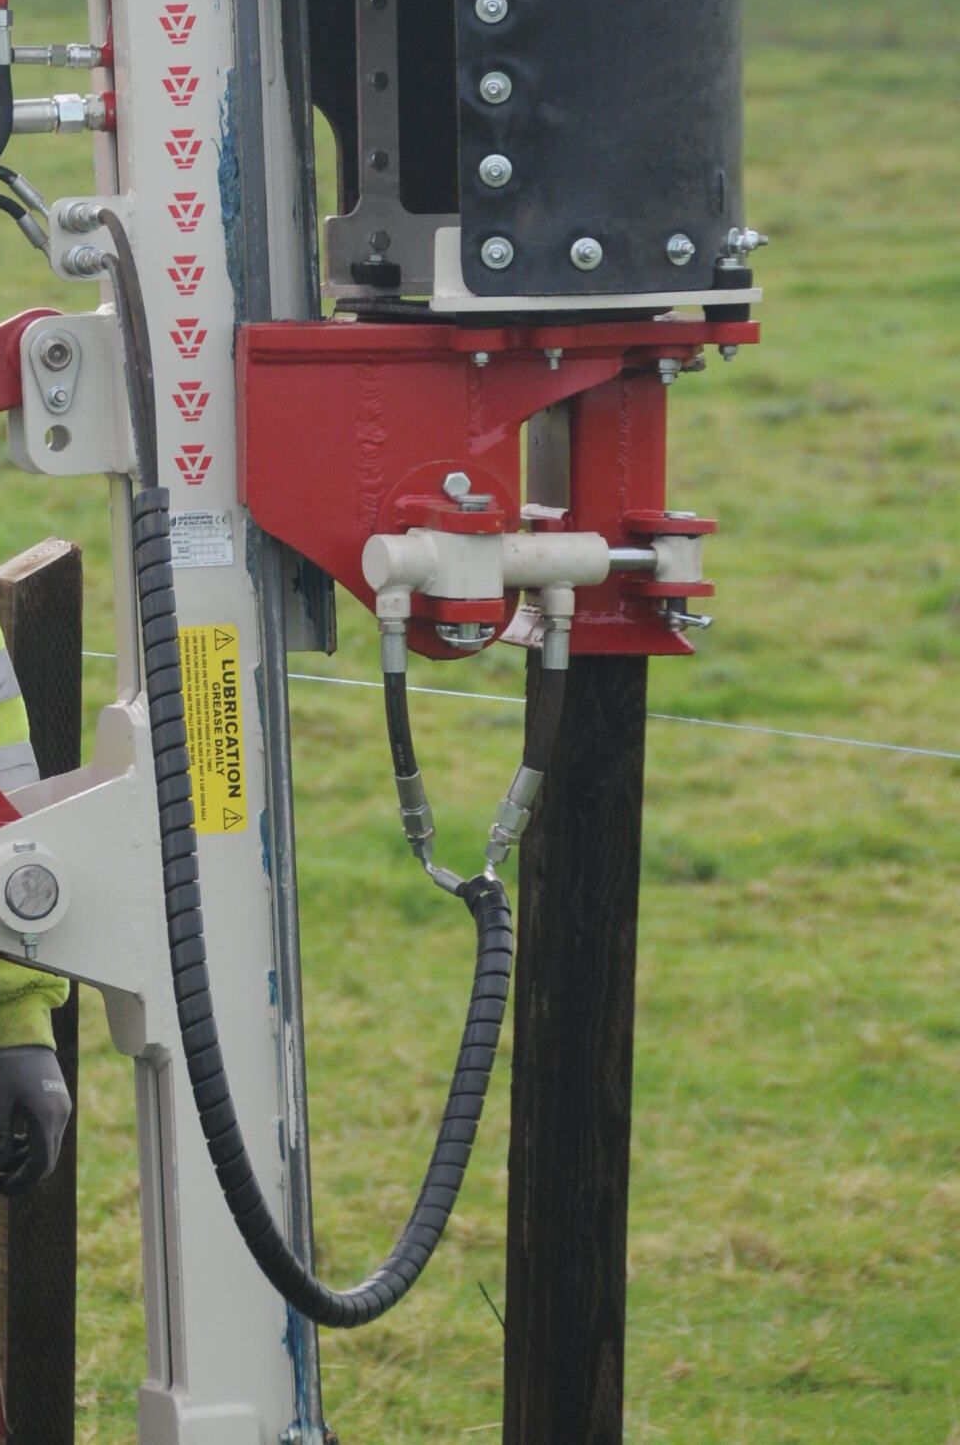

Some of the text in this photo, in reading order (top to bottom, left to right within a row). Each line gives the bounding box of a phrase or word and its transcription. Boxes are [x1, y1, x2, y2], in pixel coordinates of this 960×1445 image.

[212, 682, 225, 775] GREASE DAILY
[222, 659, 241, 798] LUBRICATION
